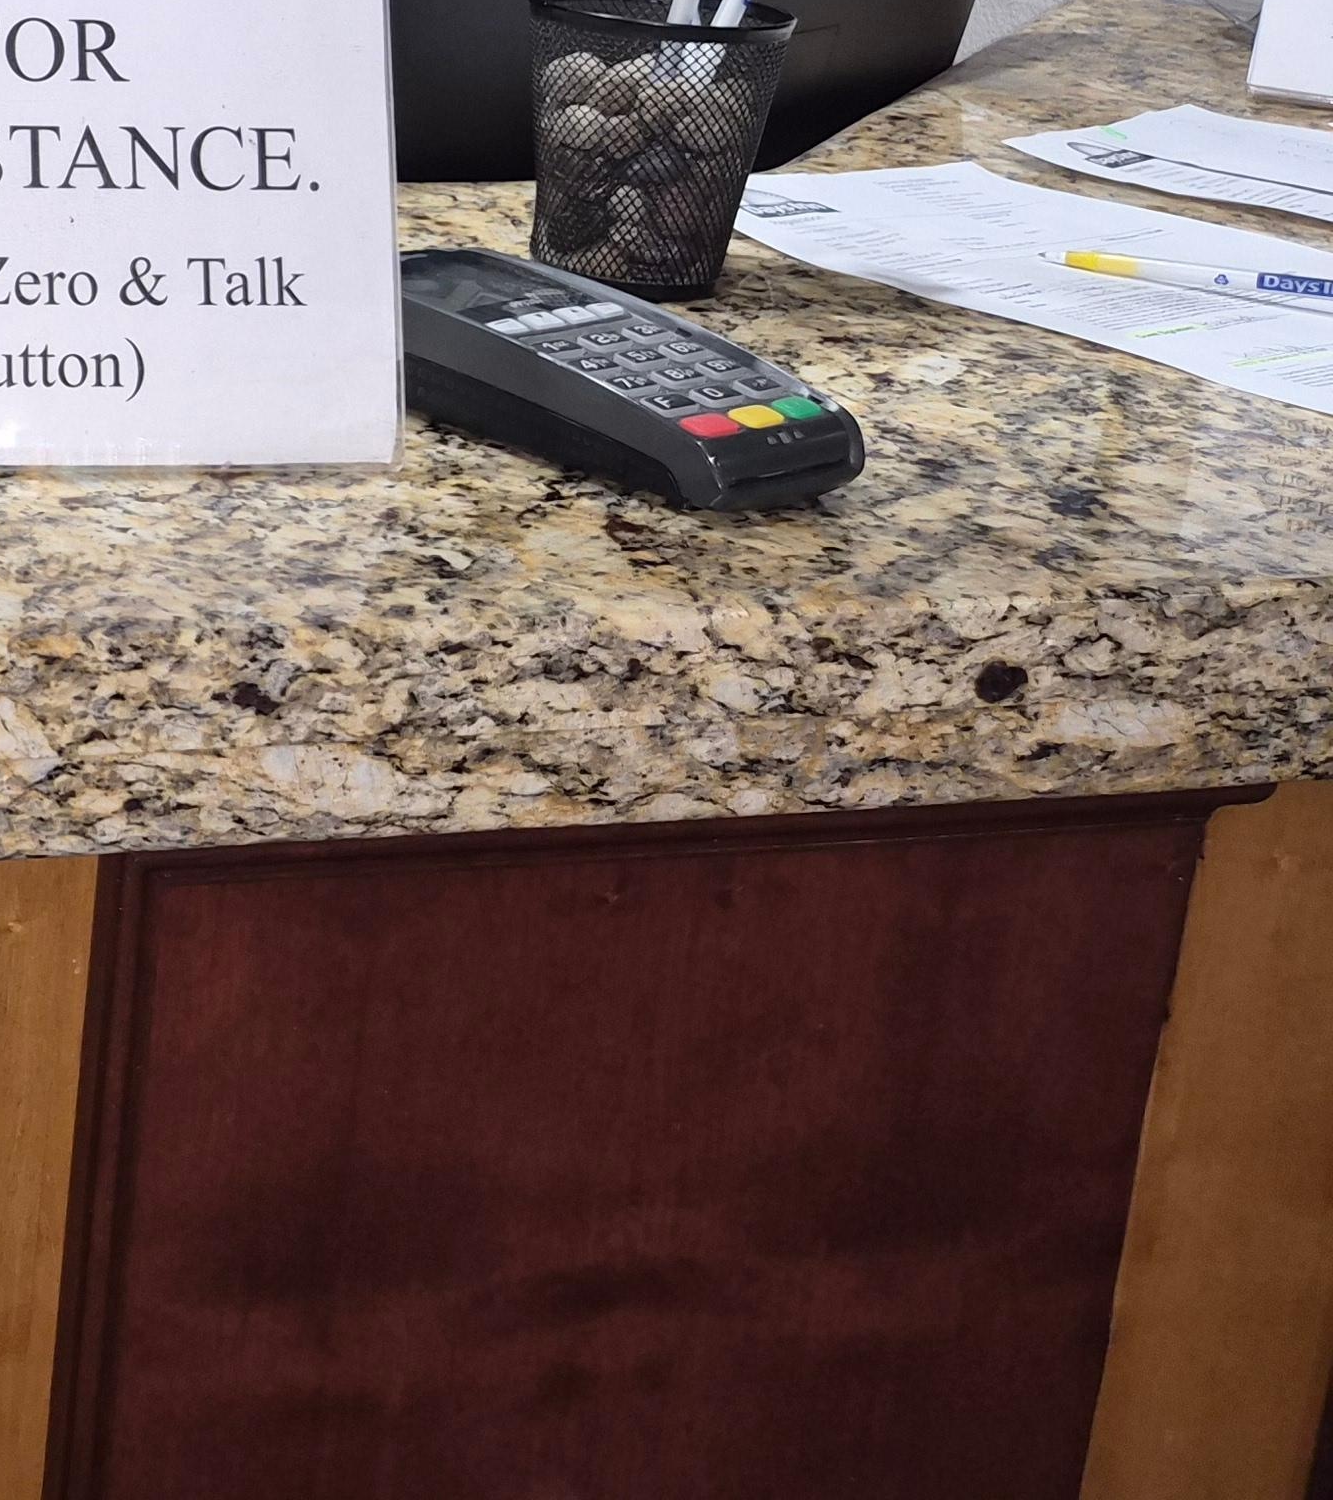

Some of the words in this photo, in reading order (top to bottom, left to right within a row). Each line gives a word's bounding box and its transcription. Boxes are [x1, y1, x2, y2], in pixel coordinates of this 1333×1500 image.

[120, 257, 167, 306] &
[187, 257, 307, 306] Talk
[1262, 273, 1320, 294] Days
